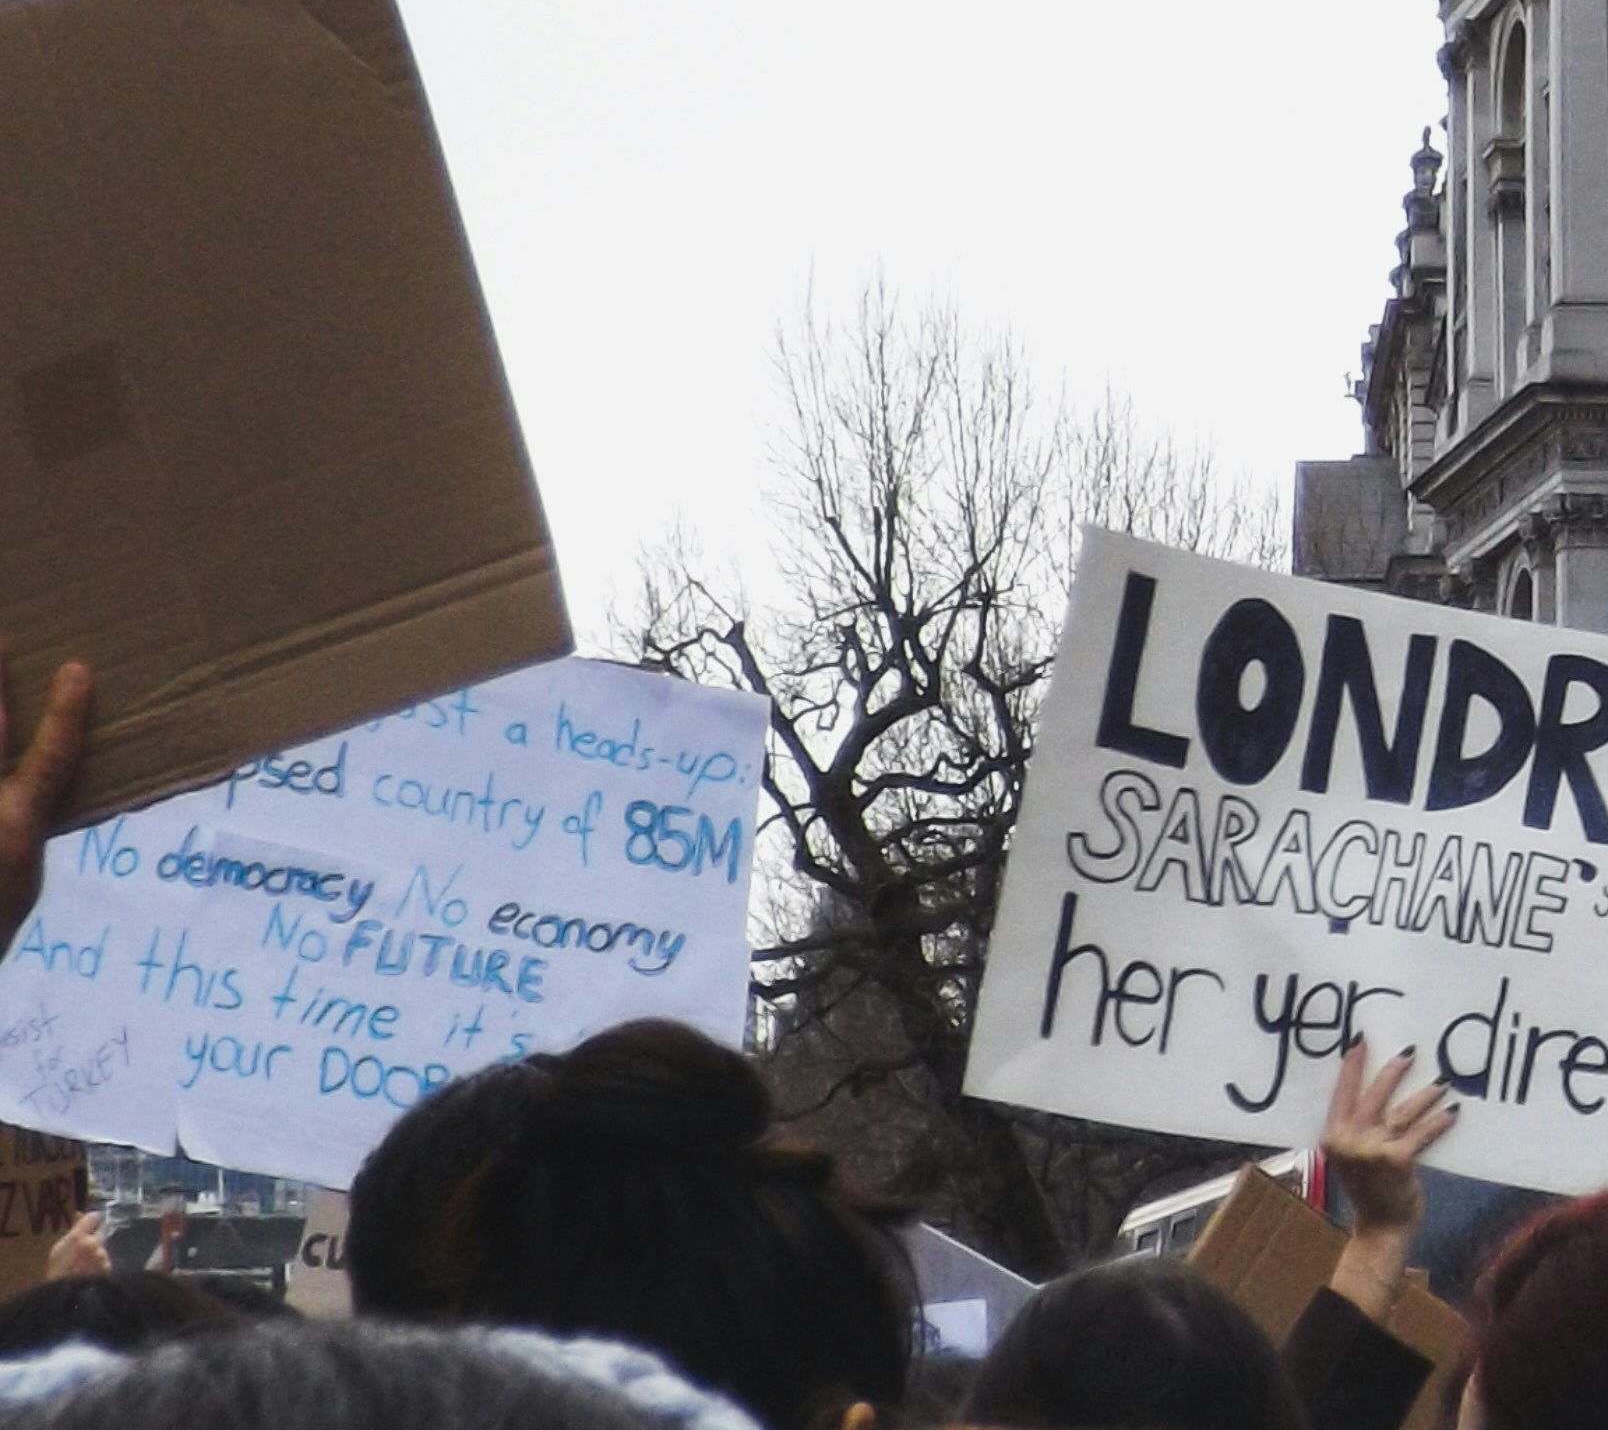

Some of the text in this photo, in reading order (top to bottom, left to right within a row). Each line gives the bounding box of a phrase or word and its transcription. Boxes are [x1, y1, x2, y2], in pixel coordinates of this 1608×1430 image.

[364, 689, 478, 736] st
[505, 723, 528, 747] a
[373, 771, 545, 851] country
[562, 790, 603, 867] of
[623, 799, 742, 884] 85M
[78, 815, 686, 977] No democracy No economy
[14, 917, 110, 980] And
[137, 926, 243, 1010] this
[271, 964, 400, 1039] time
[262, 902, 546, 1004] No FUTURE
[1041, 892, 1224, 1055] her
[1225, 973, 1405, 1113] yer
[182, 1033, 294, 1089] your
